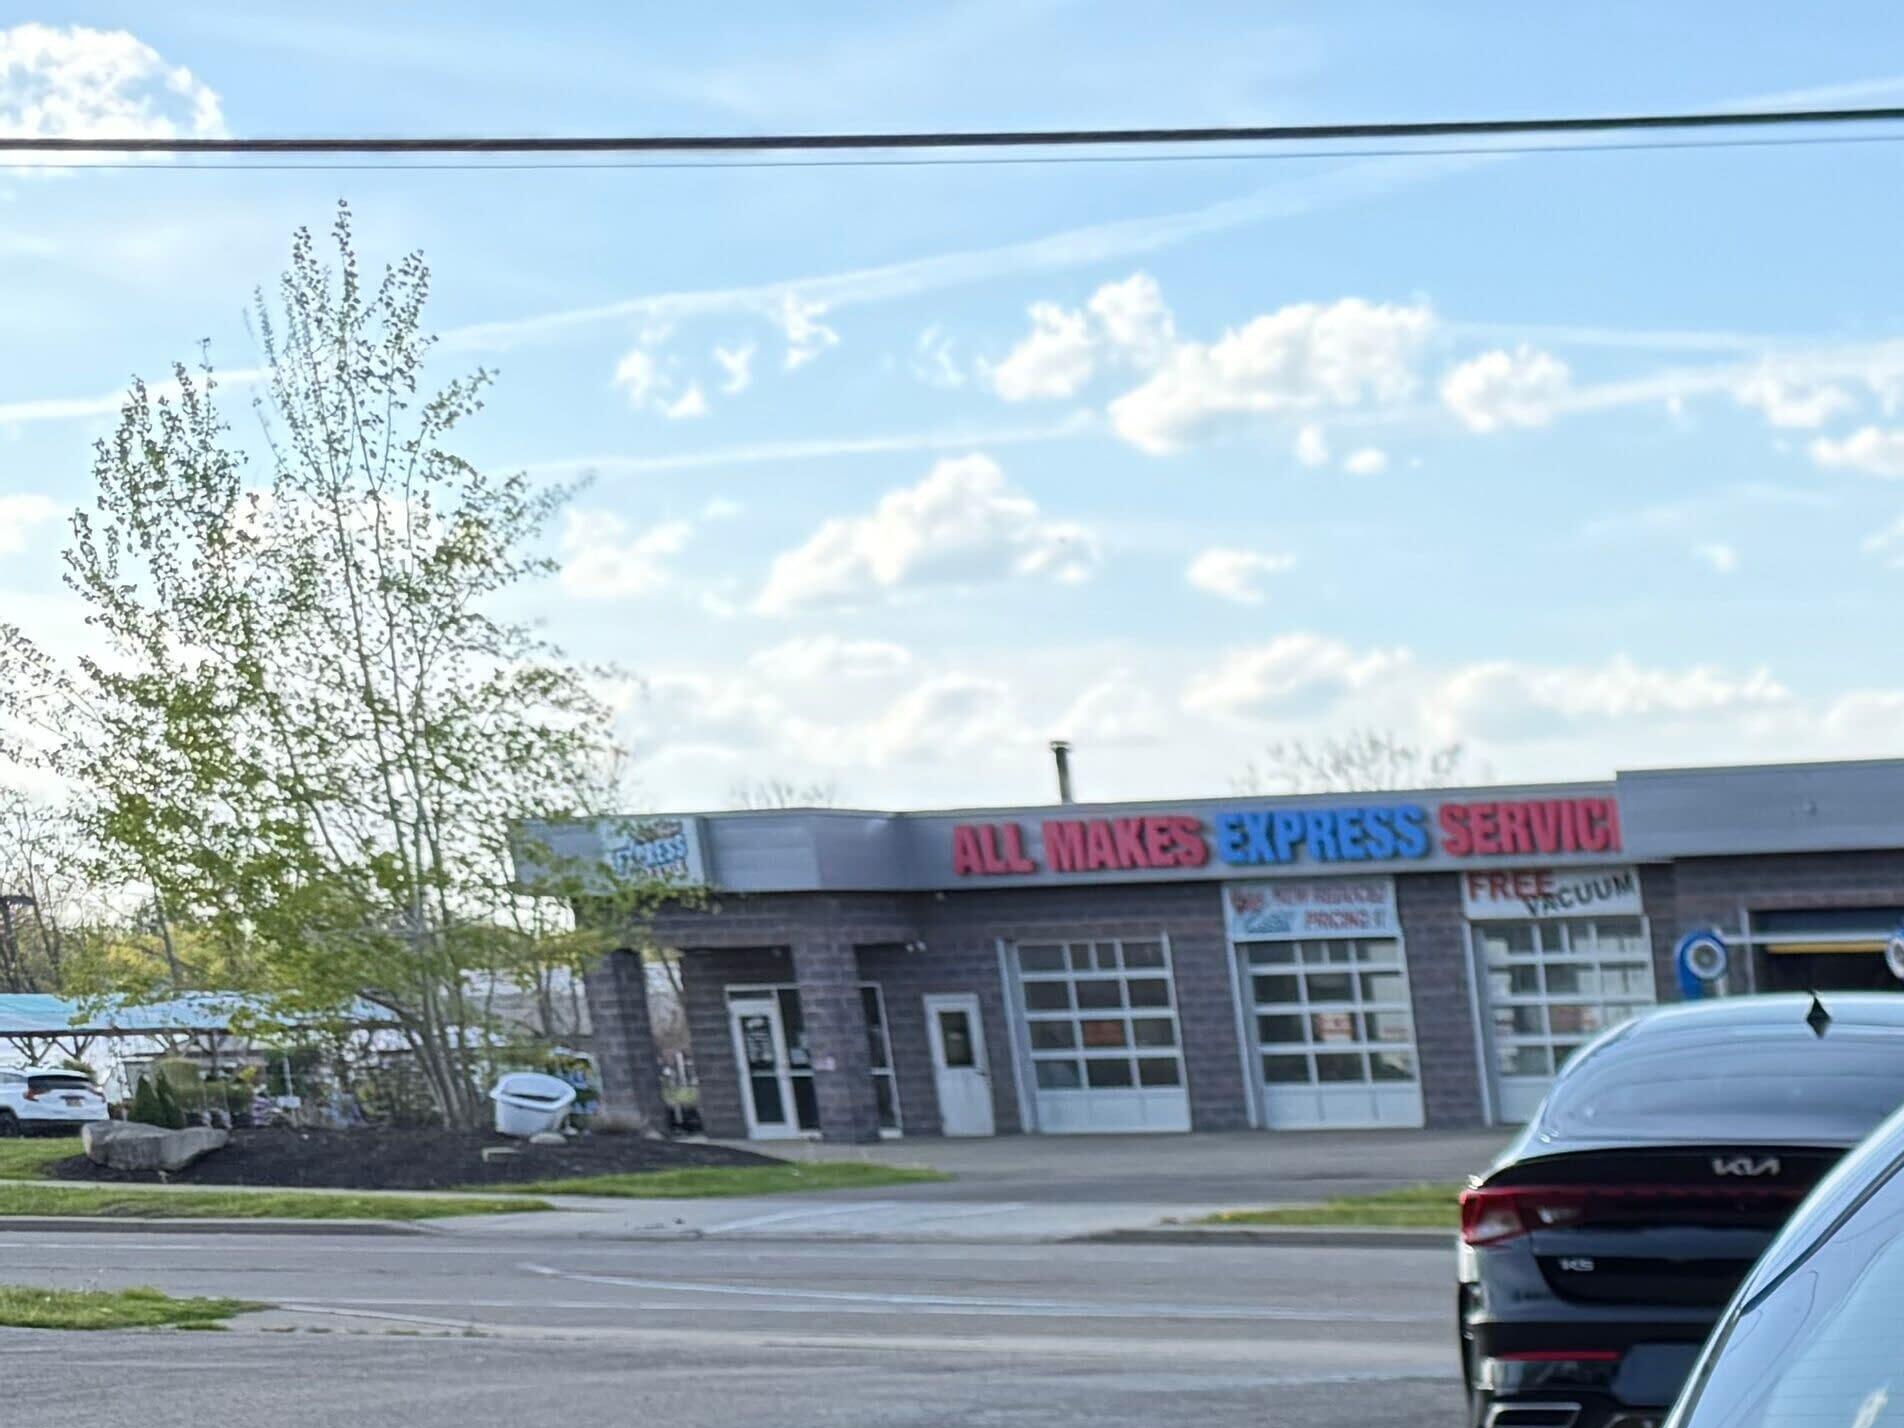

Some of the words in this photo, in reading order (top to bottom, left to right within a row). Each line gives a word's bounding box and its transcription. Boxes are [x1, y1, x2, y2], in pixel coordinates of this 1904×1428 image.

[954, 822, 1036, 876] ALL
[1042, 815, 1209, 873] MAKES
[1215, 805, 1429, 865] EXPRESS
[1467, 869, 1553, 901] FREE
[1524, 870, 1636, 916] VACUUM
[1713, 1157, 1780, 1176] KIA
